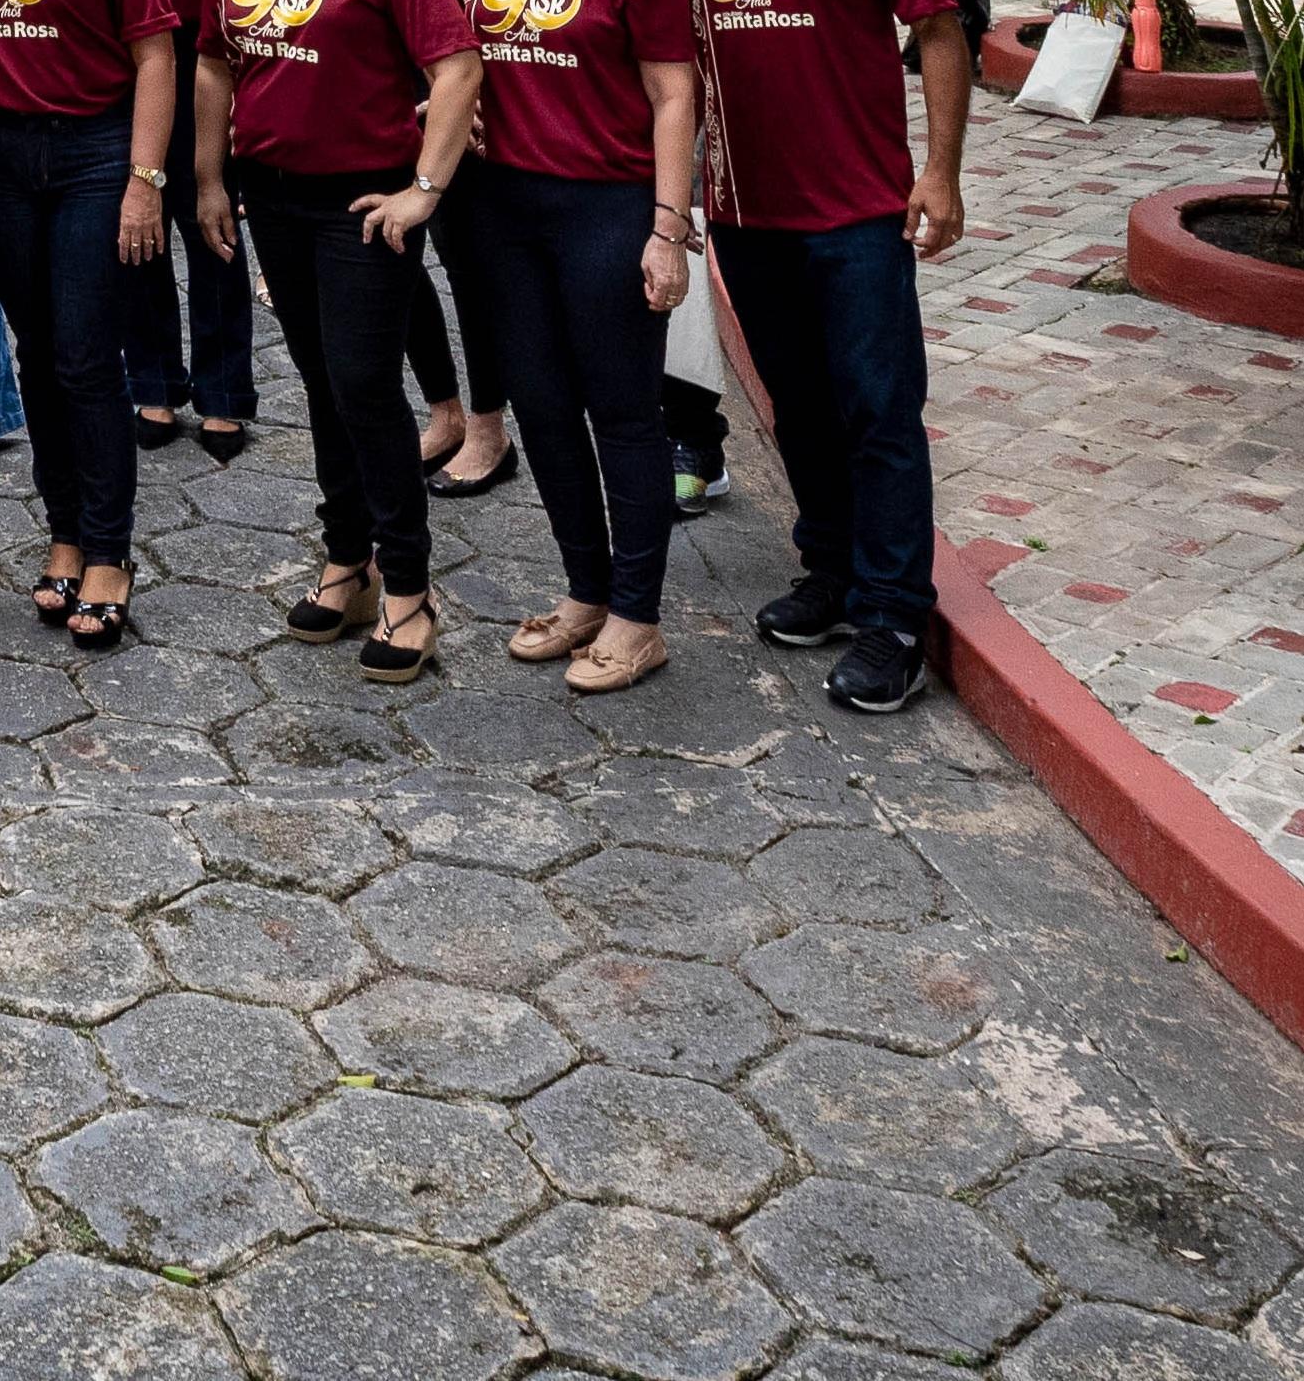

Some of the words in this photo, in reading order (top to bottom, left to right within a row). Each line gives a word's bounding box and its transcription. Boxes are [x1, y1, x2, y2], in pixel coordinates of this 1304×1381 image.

[14, 21, 59, 38] Rosa
[713, 12, 763, 31] Santa
[764, 10, 815, 27] Rosa
[276, 42, 319, 64] Rosa
[481, 43, 531, 62] Santa
[533, 46, 579, 68] Rosa
